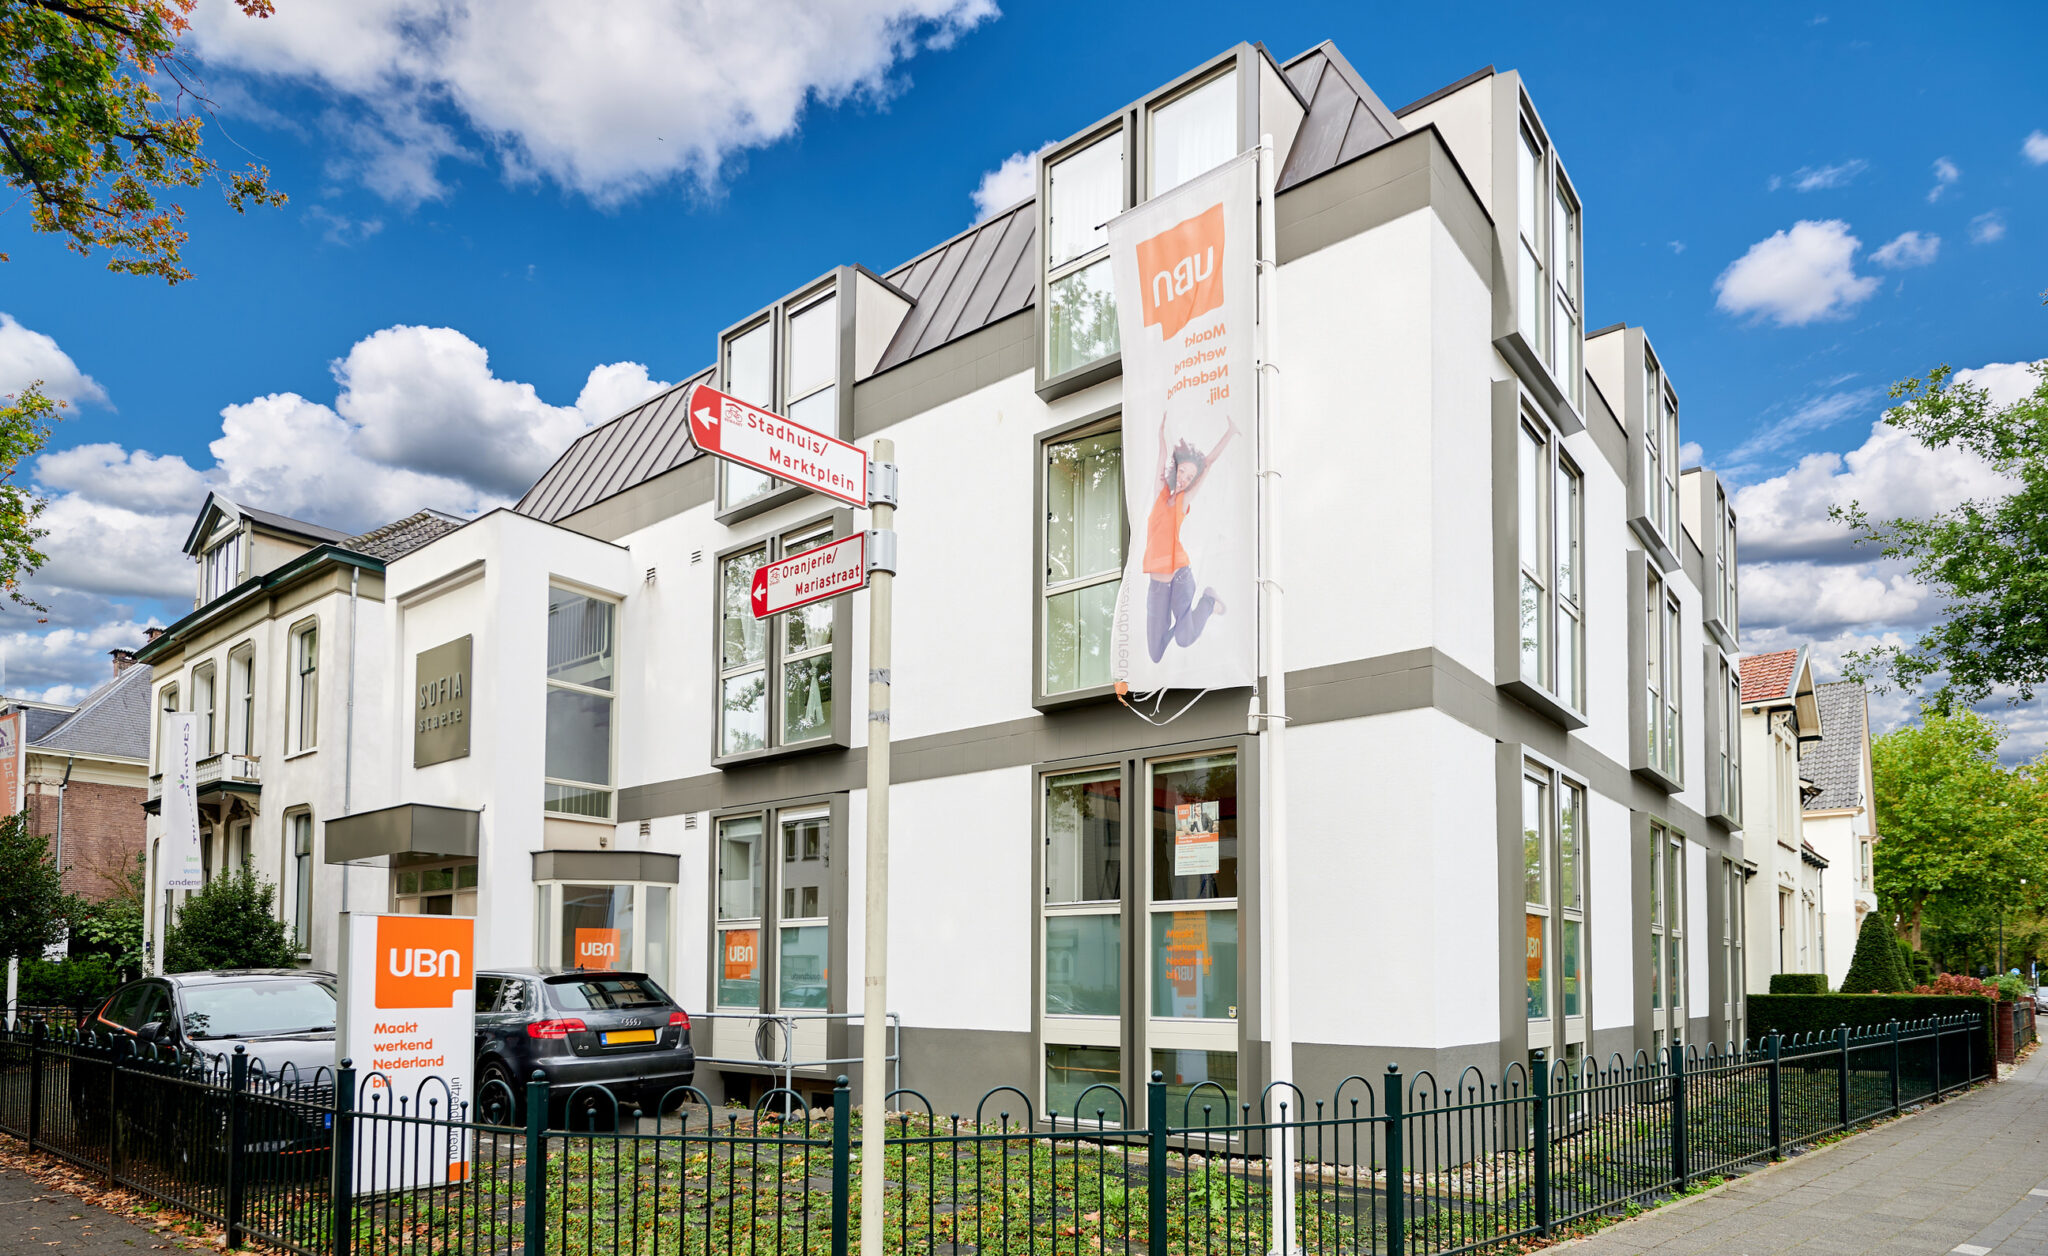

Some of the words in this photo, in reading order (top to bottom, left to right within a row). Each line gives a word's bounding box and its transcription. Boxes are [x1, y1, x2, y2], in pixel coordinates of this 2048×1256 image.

[747, 412, 829, 456] Stadhuis/
[769, 446, 854, 491] Marktplein
[782, 547, 838, 579] Oranjerie/
[795, 564, 860, 596] Mariastraat
[420, 672, 463, 710] SOFIA
[418, 708, 462, 733] staete
[374, 1021, 418, 1034] Maakt
[373, 1038, 433, 1052] werkend
[373, 1055, 444, 1070] Nederland
[450, 1076, 462, 1160] uitzendureau
